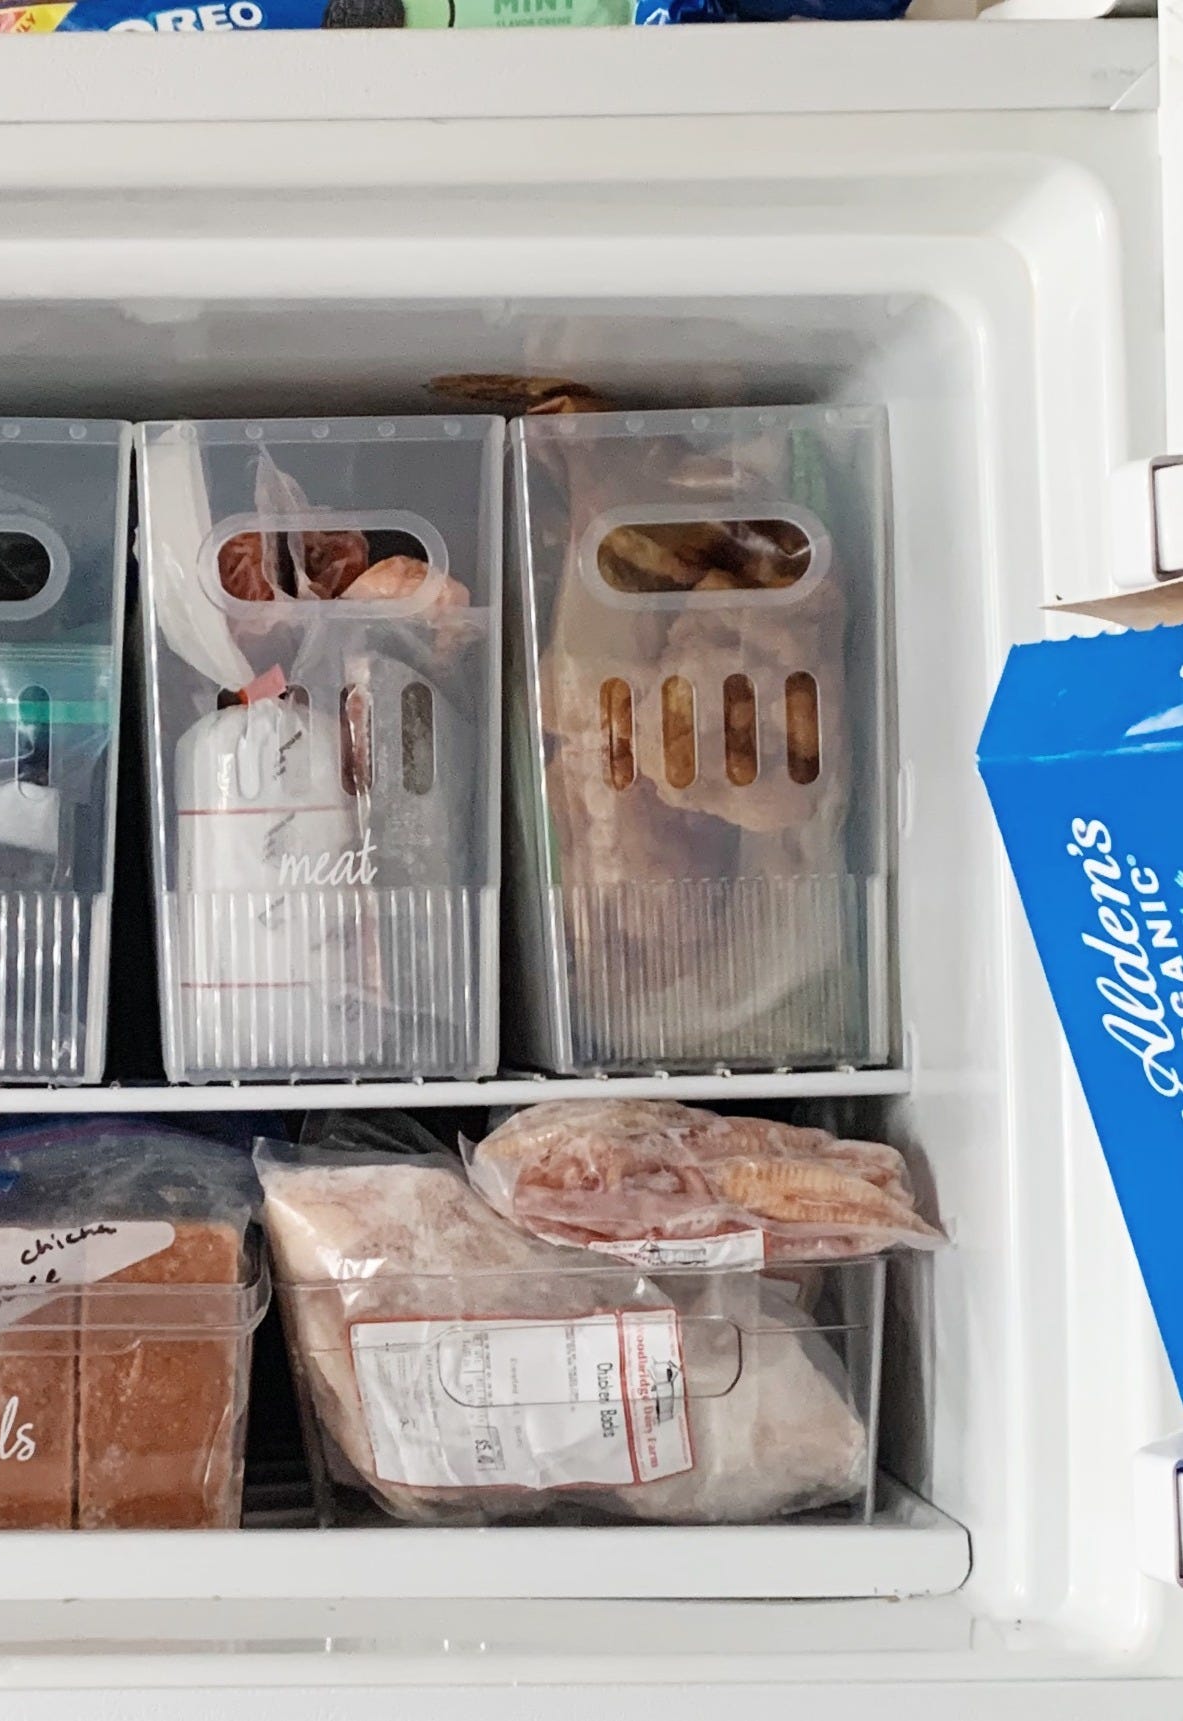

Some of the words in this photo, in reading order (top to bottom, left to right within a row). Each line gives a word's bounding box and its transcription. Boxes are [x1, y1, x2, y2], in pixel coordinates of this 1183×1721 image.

[279, 828, 378, 886] meat
[1066, 816, 1183, 1098] Alden's
[600, 1409, 619, 1439] Backs
[647, 1437, 660, 1469] Farm
